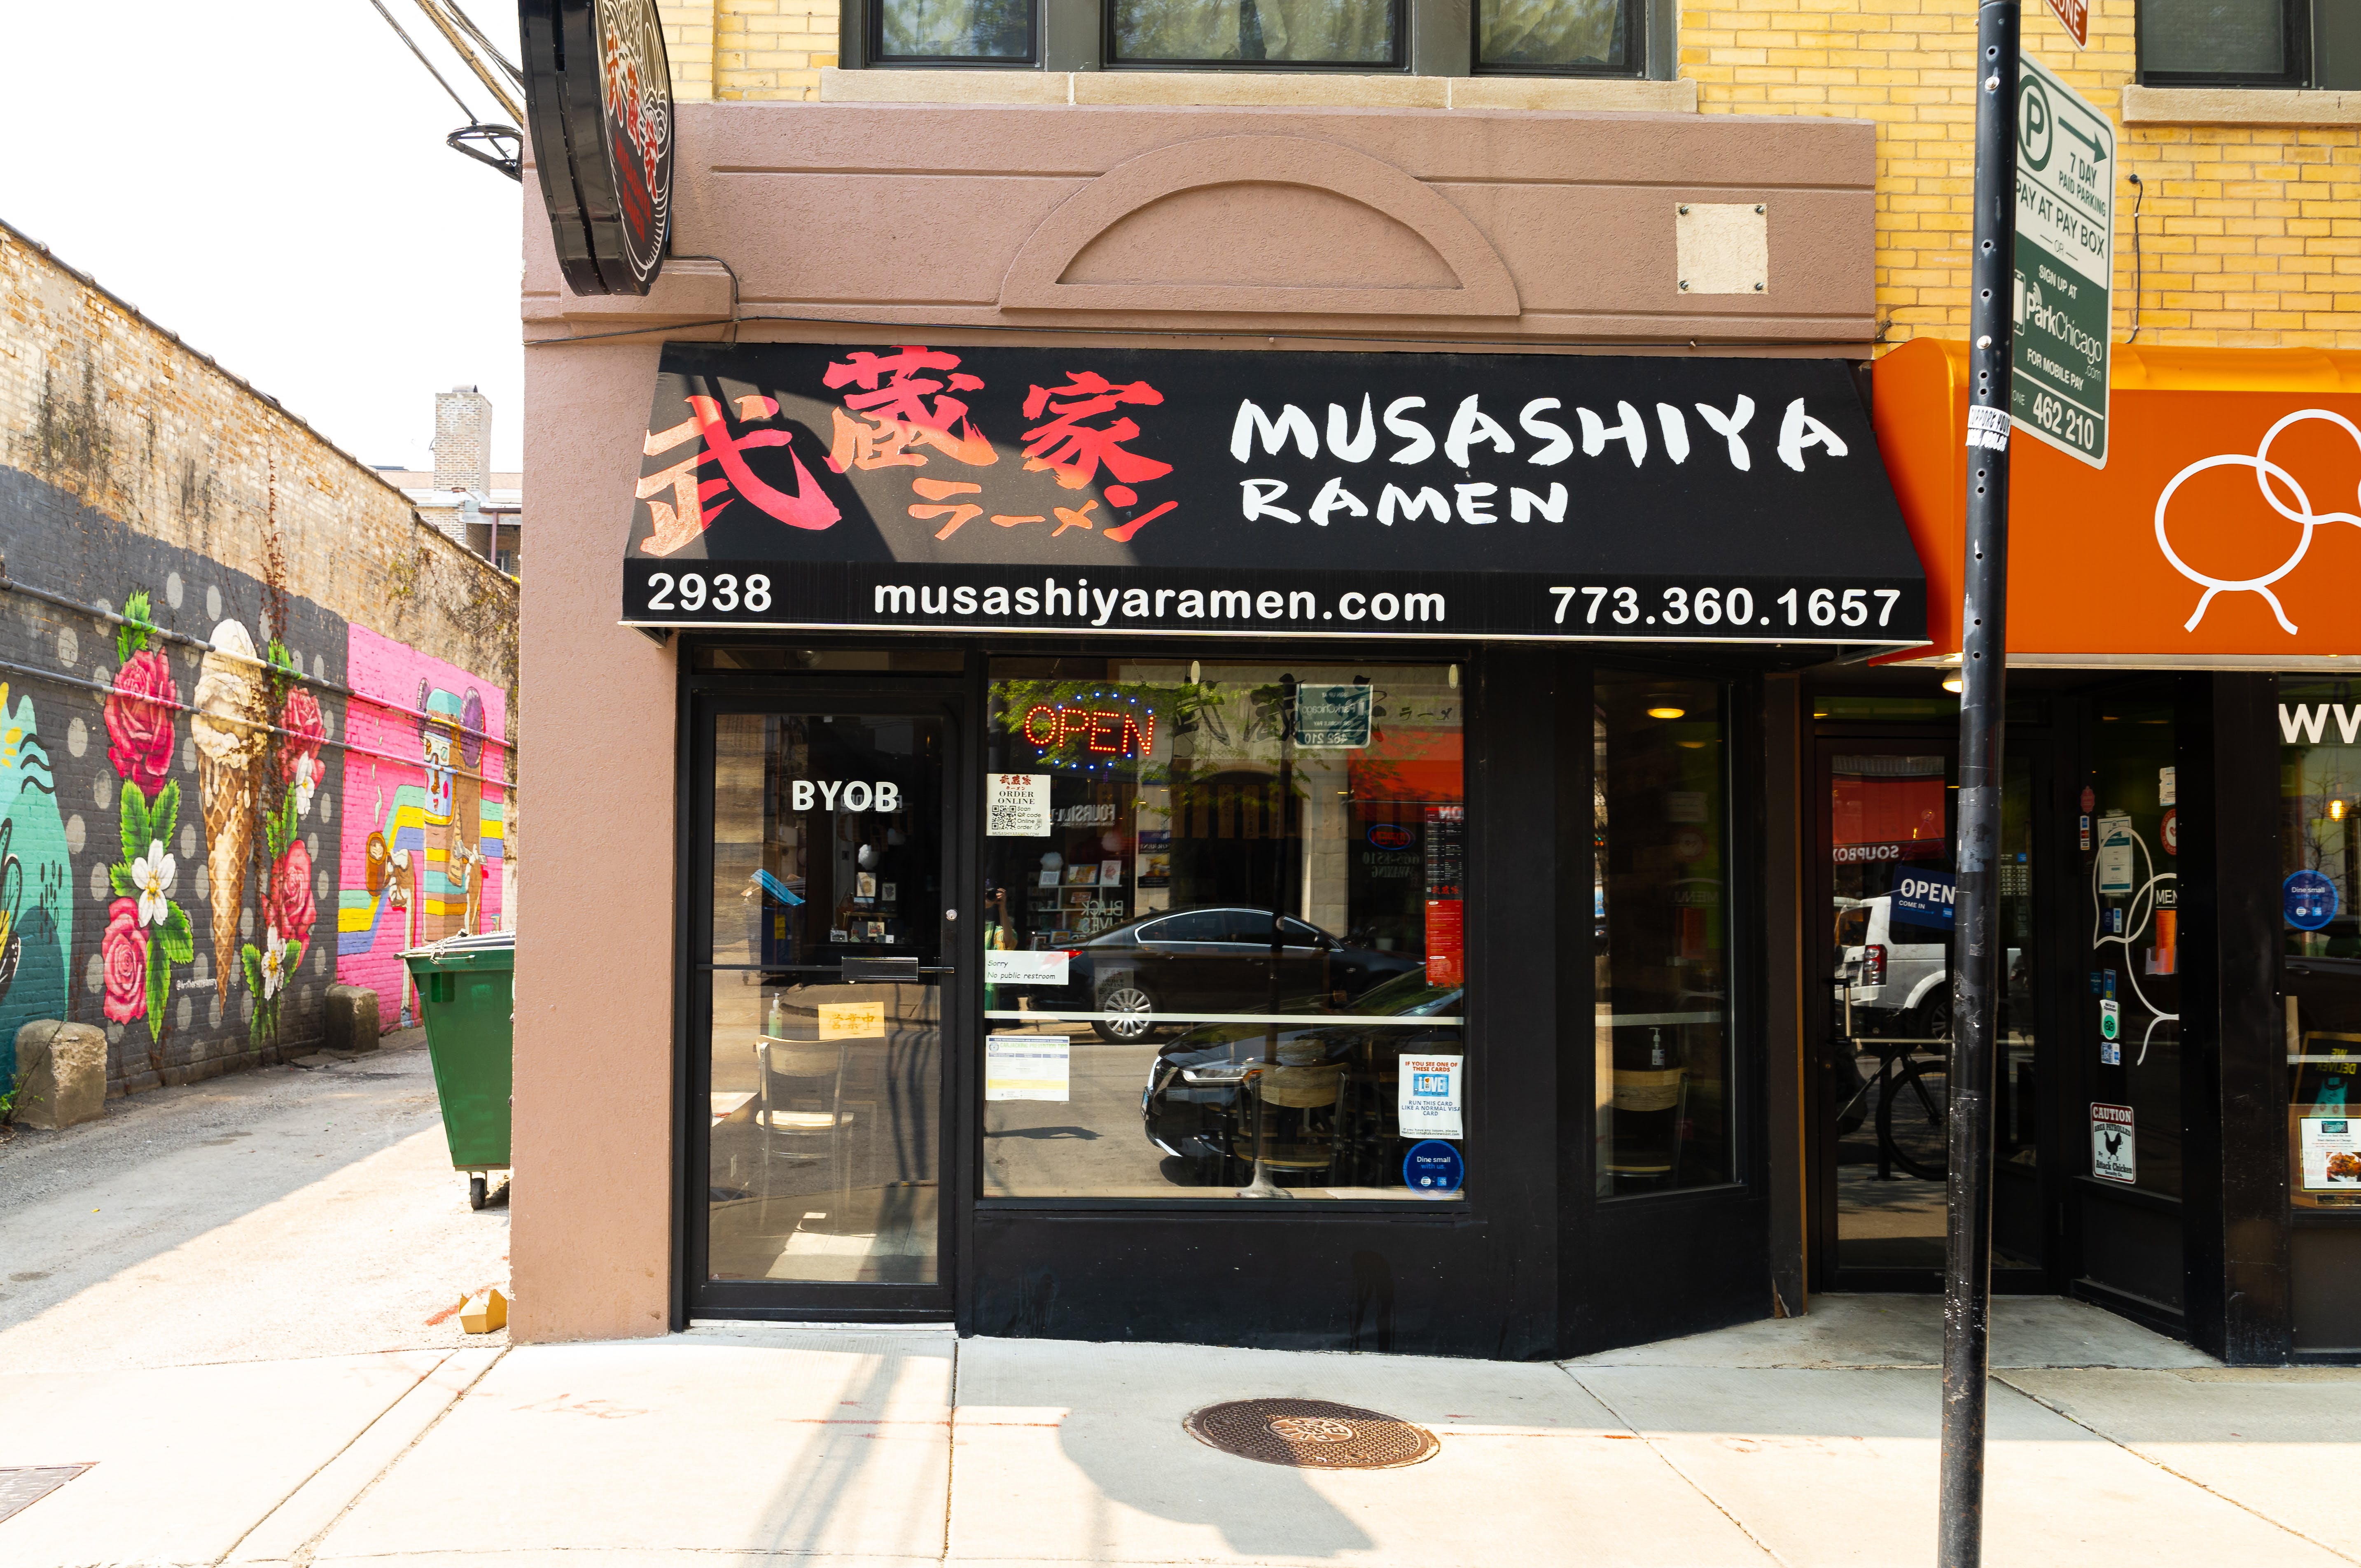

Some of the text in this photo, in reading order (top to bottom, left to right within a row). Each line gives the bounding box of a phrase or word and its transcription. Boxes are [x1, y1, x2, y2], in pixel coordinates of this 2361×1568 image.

[2070, 152, 2097, 189] 7 DAY
[2059, 170, 2106, 217] PAID PARKING
[2016, 177, 2104, 259] PAY AT PAY BOX
[2054, 240, 2064, 256] OR
[2039, 264, 2078, 300] SIGN UP AT
[2026, 292, 2102, 365] ParkChicago
[2027, 348, 2084, 391] FOR MOBILE PAY
[2085, 365, 2101, 382] .com
[1230, 391, 1848, 472] MUSASHIYA
[2012, 390, 2094, 450] ONE 462 210
[908, 477, 1178, 542] ラーメン
[1239, 476, 1568, 526] RAMEN
[648, 572, 772, 612] 2938
[875, 578, 1445, 626] musashiyaramen.com
[1549, 587, 1900, 627] 773.360.1657
[1025, 705, 1154, 755] OPEN
[792, 780, 898, 812] BYOB
[1901, 878, 1956, 904] OPEN
[2156, 889, 2177, 904] MEN
[2093, 1106, 2132, 1123] CAUTION
[2096, 1160, 2132, 1174] Attack Chicken
